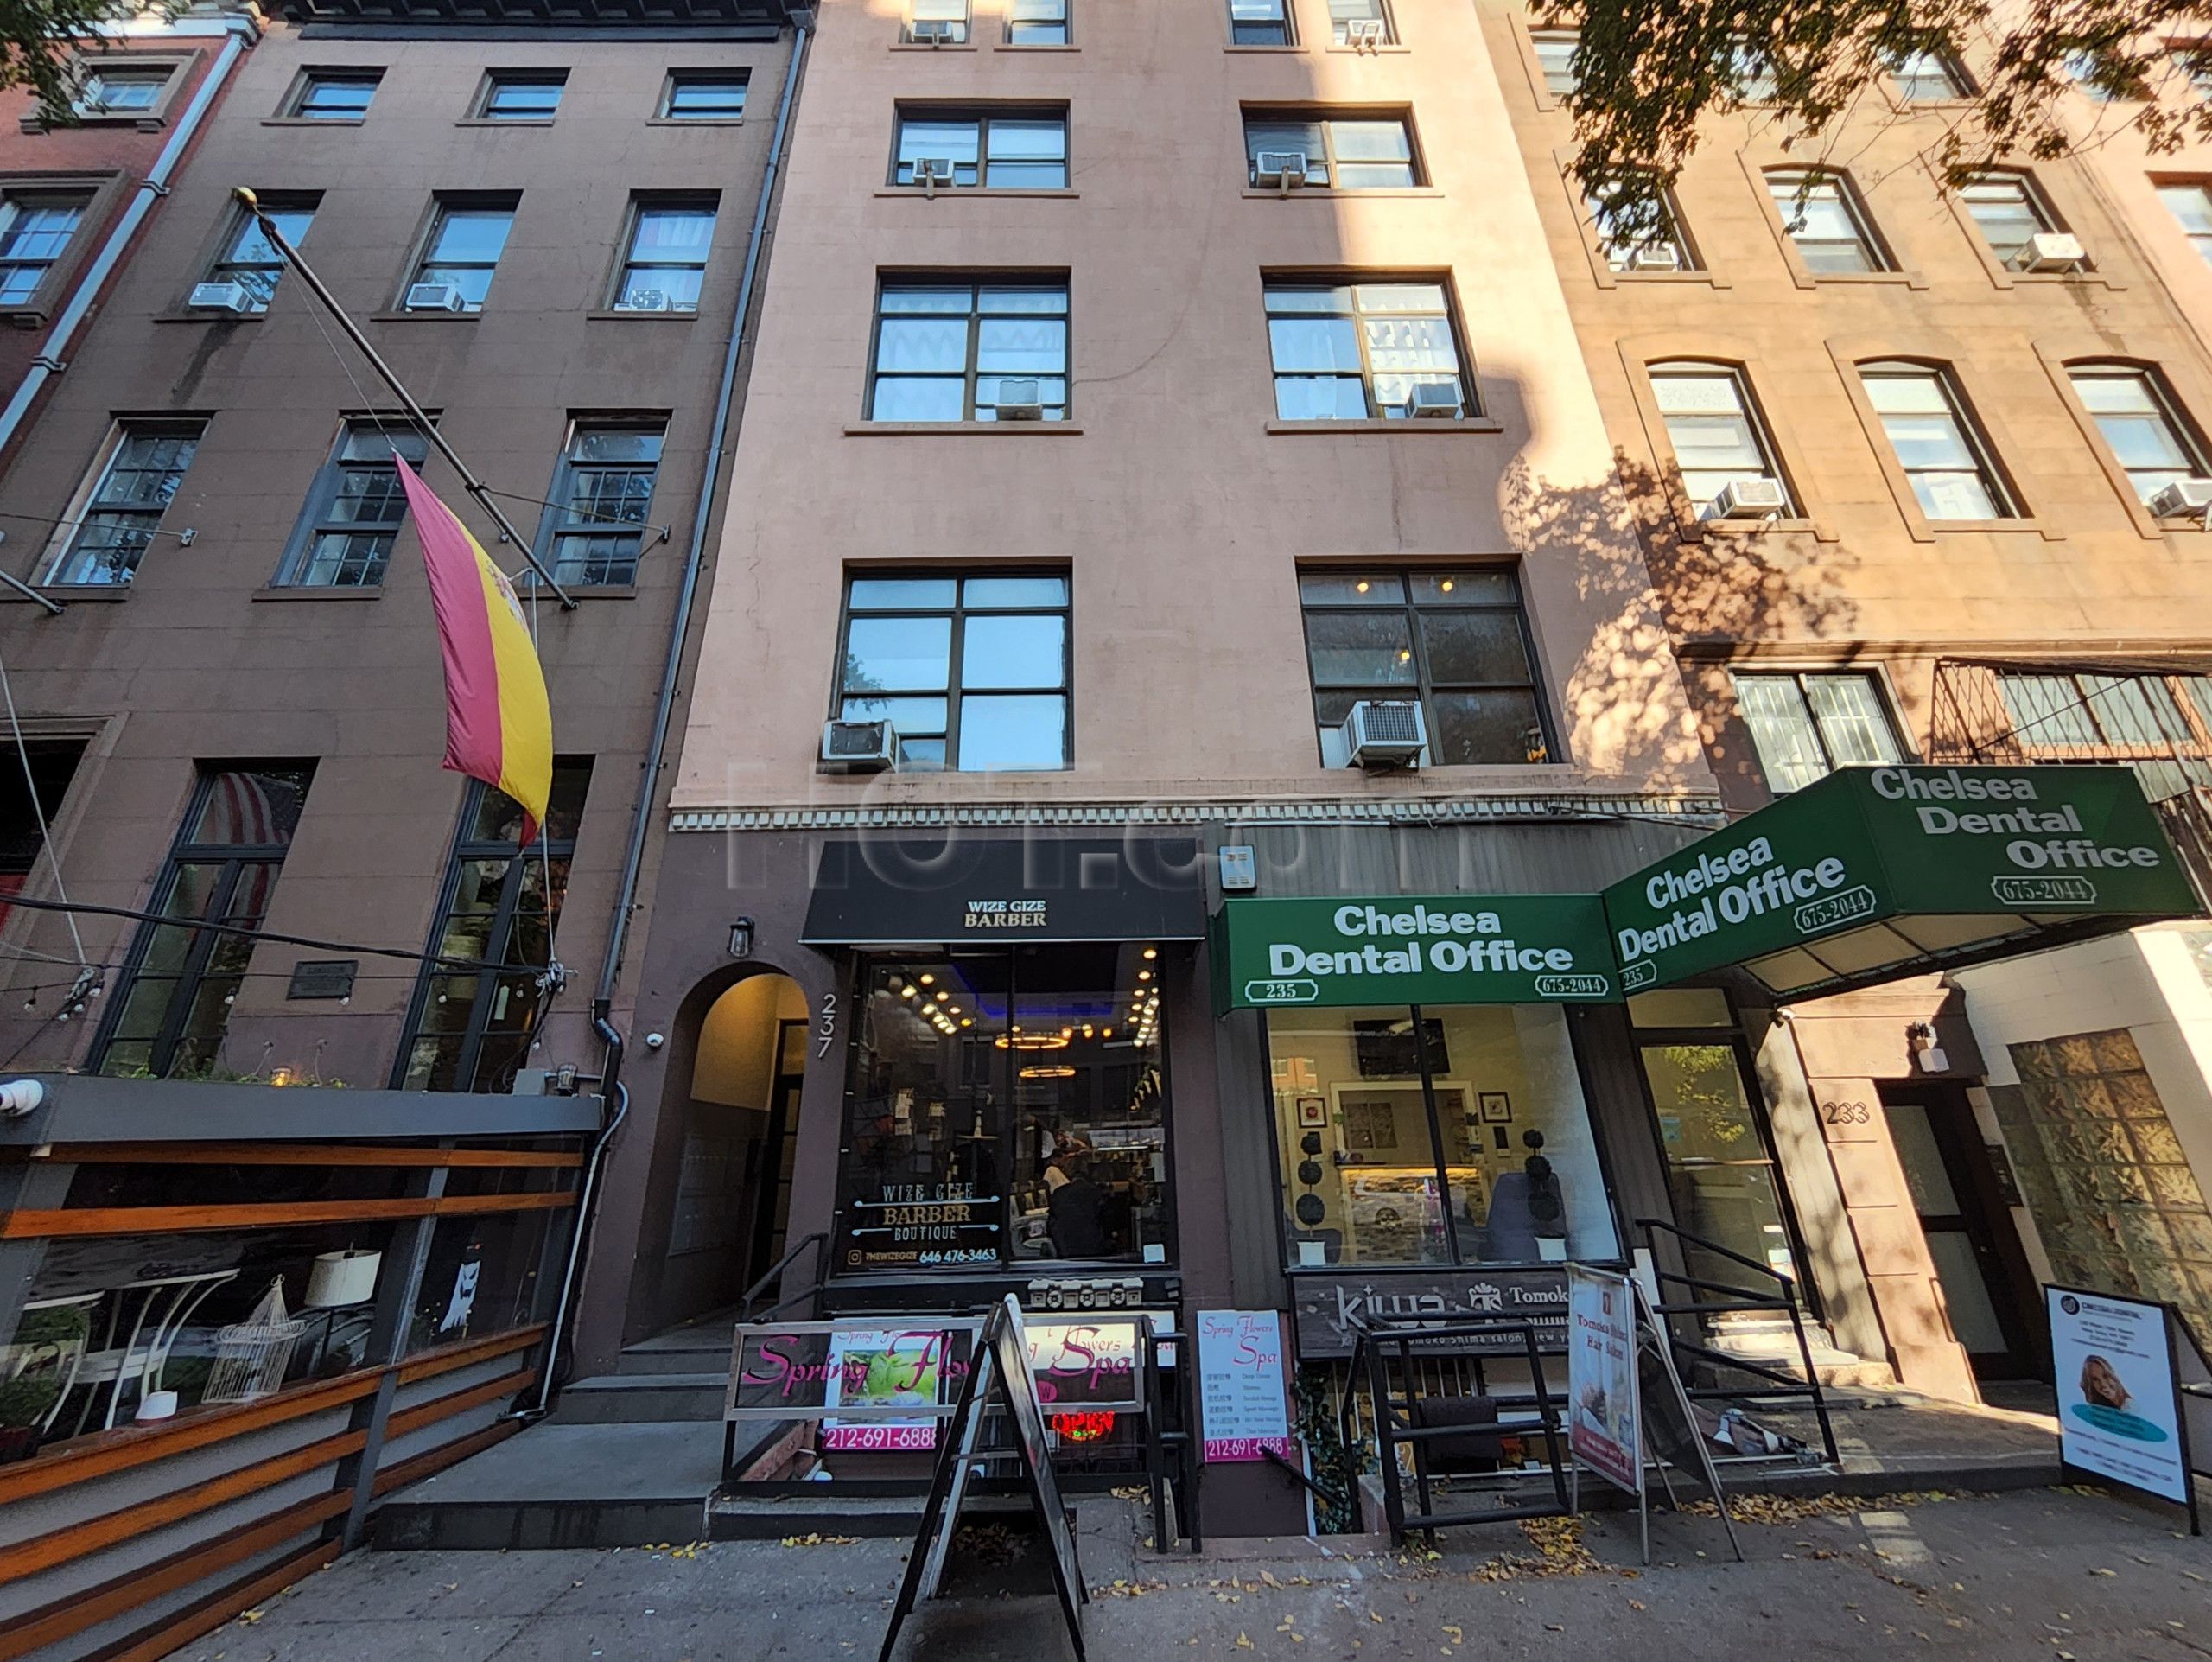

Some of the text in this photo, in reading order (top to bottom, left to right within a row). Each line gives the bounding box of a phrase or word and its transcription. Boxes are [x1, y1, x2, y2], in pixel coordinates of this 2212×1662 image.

[1870, 768, 2038, 800] Chelsea
[1917, 805, 2083, 834] Dental
[2005, 840, 2160, 869] Office
[1646, 837, 1773, 910] Chelsea
[2002, 879, 2088, 901] 675-2044
[968, 900, 1046, 913] WIZE GIZE
[1618, 856, 1846, 962] Dental Office
[1801, 891, 1868, 928] 675-2044
[964, 912, 1047, 929] BARBER
[1333, 904, 1502, 936] Chelsea
[1268, 939, 1573, 976] Dental Office
[1541, 977, 1602, 994] 675-2044
[1623, 966, 1643, 986] 235
[1265, 984, 1296, 998] 235
[817, 993, 836, 1059] 237
[1822, 1100, 1870, 1125] 233
[882, 1184, 925, 1202] WIZE
[882, 1205, 971, 1226] BARBER
[894, 1226, 957, 1241] BOUTIQUE
[919, 1248, 997, 1264] 646 476-3463
[1509, 1285, 1569, 1304] Tomok
[1203, 1315, 1273, 1339] Spring Flowers
[742, 1334, 870, 1398] Spring
[1047, 1327, 1133, 1390] Spa
[1233, 1336, 1277, 1372] Spa
